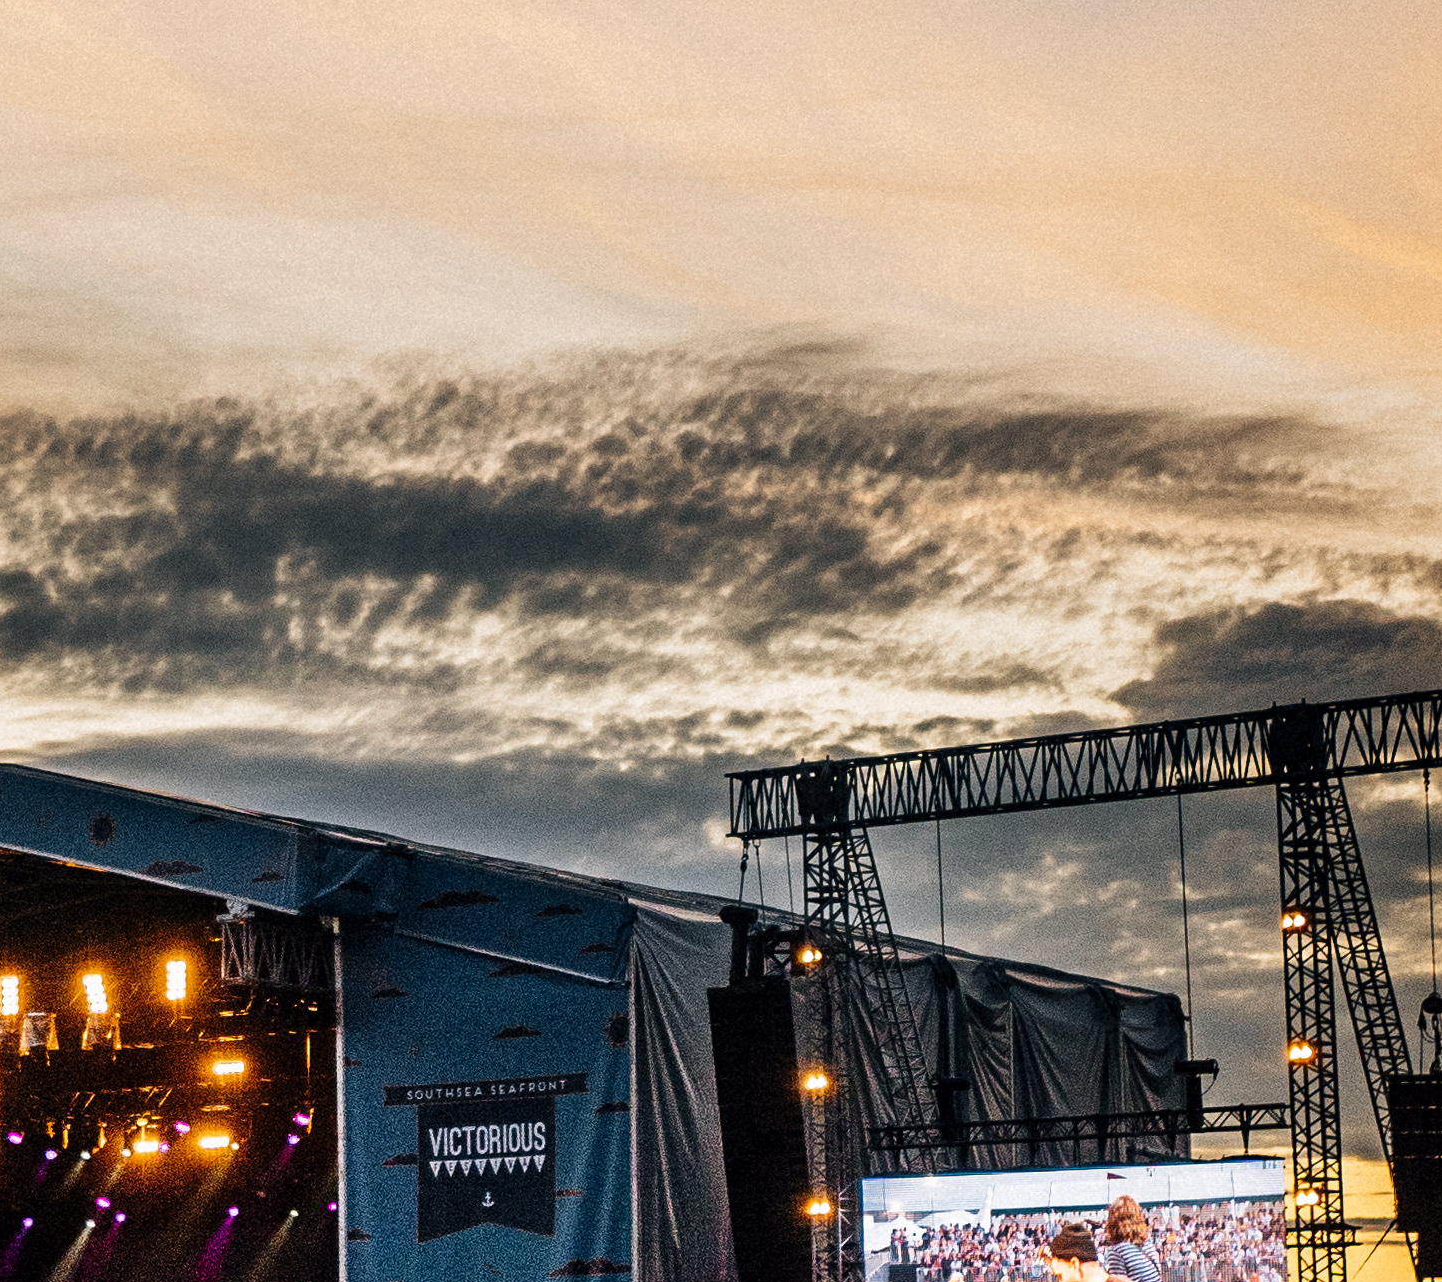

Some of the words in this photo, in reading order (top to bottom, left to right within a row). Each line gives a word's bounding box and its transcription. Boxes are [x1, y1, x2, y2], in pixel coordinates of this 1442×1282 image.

[406, 1086, 483, 1101] SOUTHSEA
[490, 1079, 568, 1096] SEAFRONT
[428, 1121, 547, 1158] VICTORIOUS
